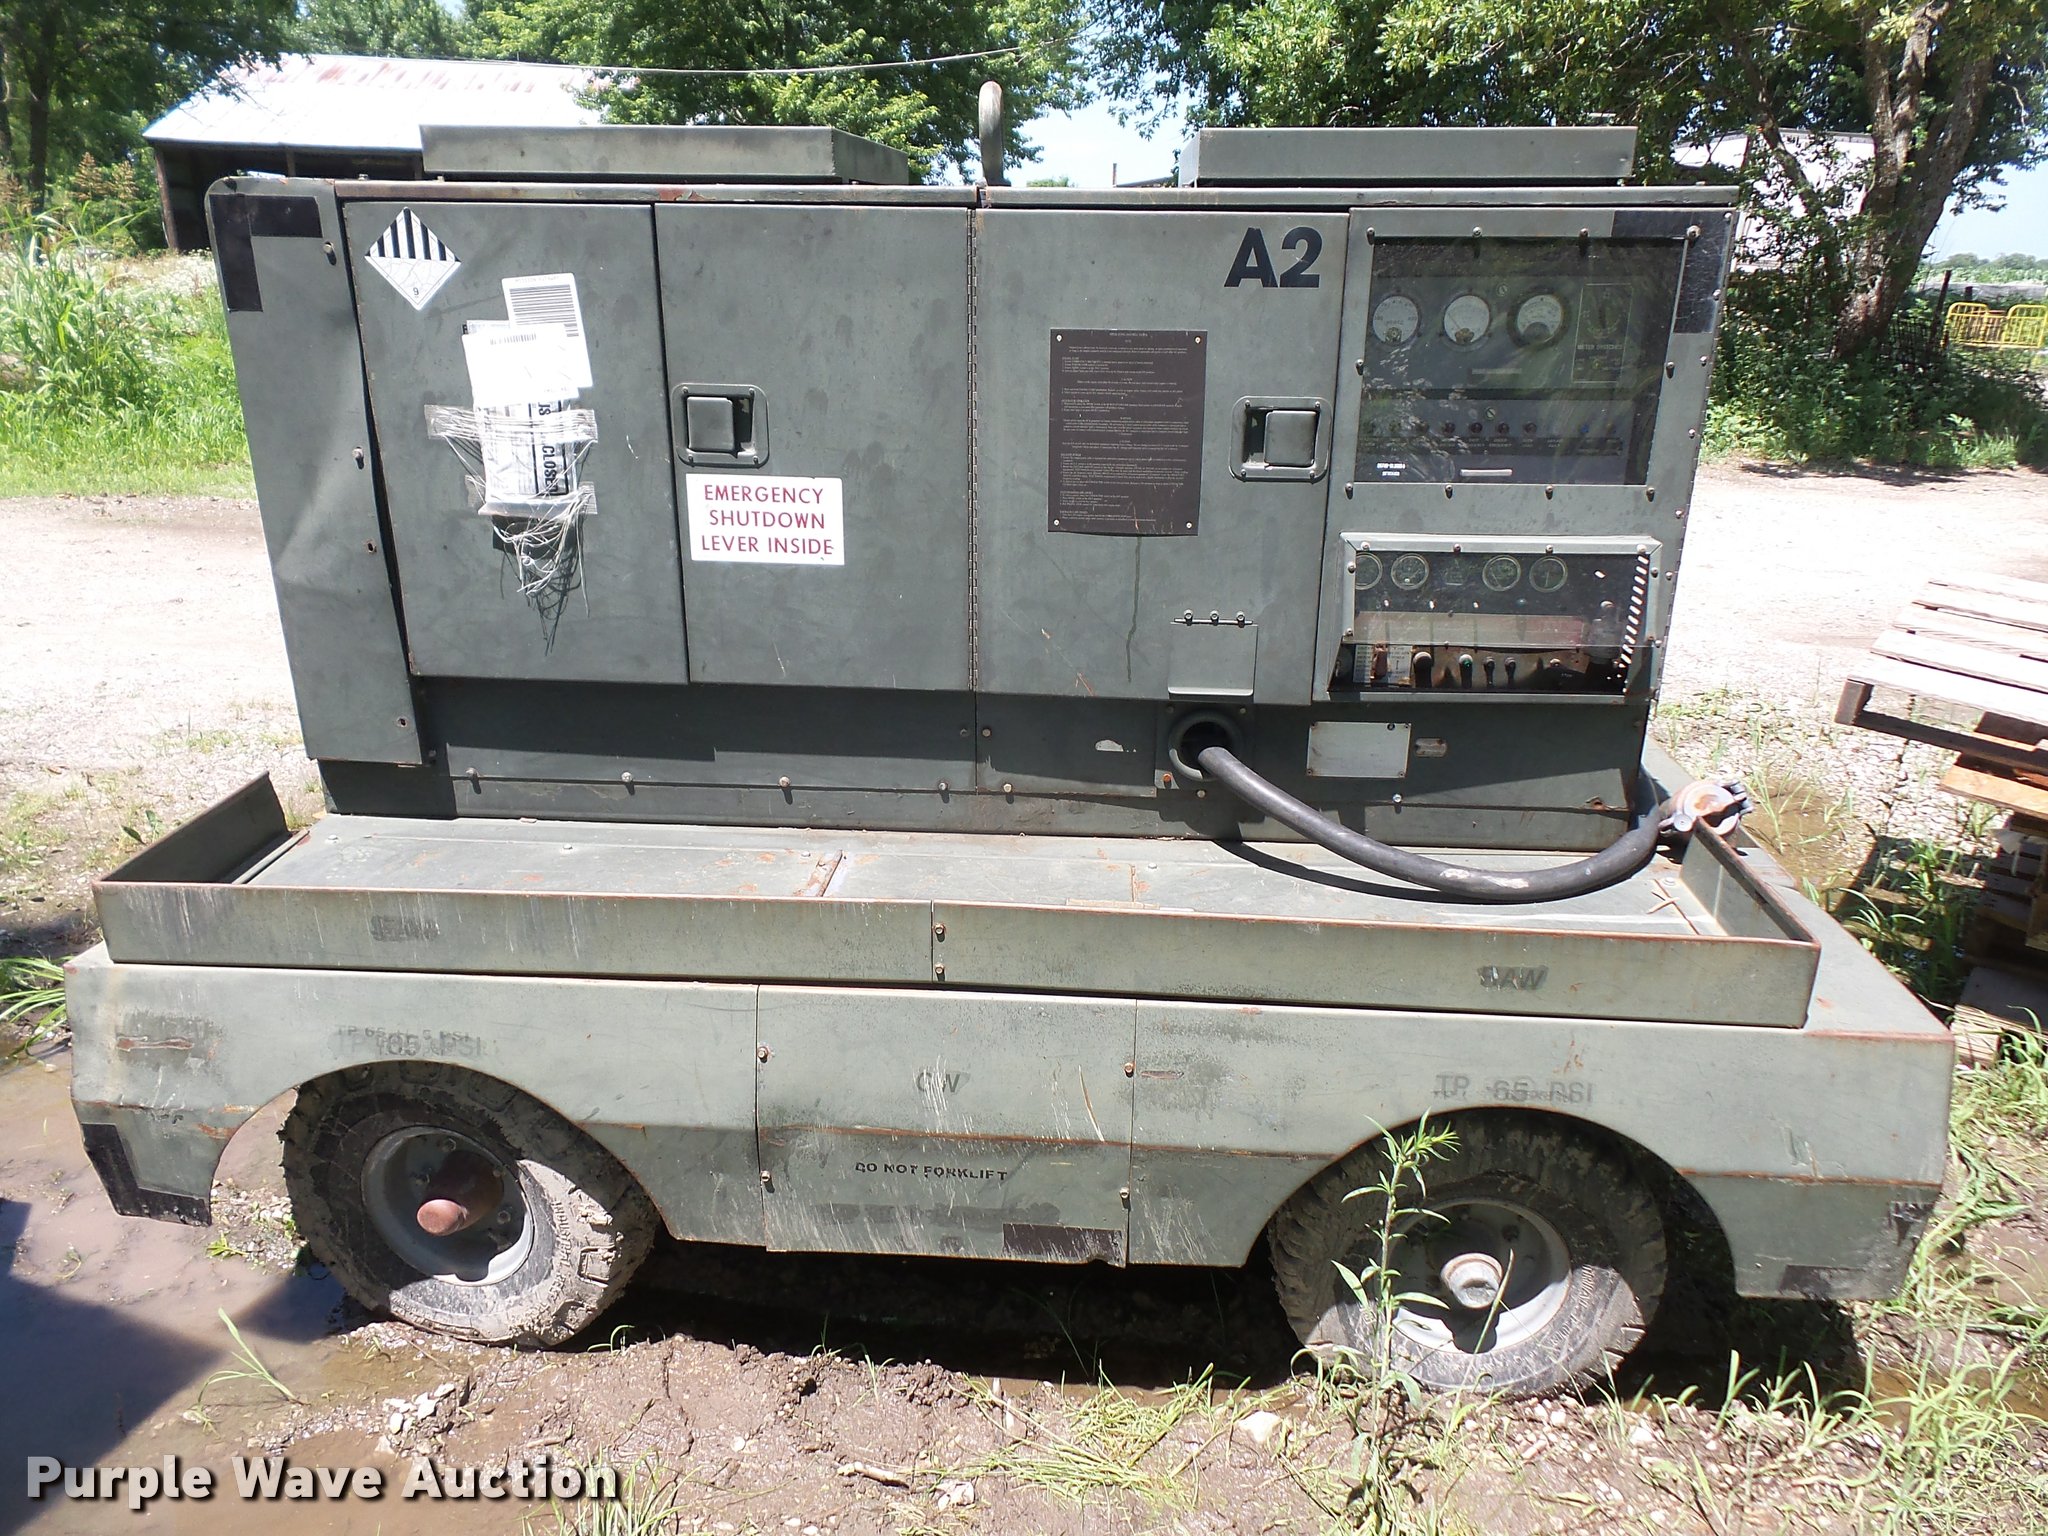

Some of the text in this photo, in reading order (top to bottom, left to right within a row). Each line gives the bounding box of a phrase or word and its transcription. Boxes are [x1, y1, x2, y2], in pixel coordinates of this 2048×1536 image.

[1224, 226, 1322, 288] A2
[412, 286, 420, 296] 9
[541, 443, 559, 493] CLOSED
[704, 484, 823, 504] EMERGENCY
[709, 509, 825, 529] SHUTDOWN
[701, 535, 834, 555] LEVER INSIDE
[855, 1162, 1008, 1181] DO NOT FORKLIFT
